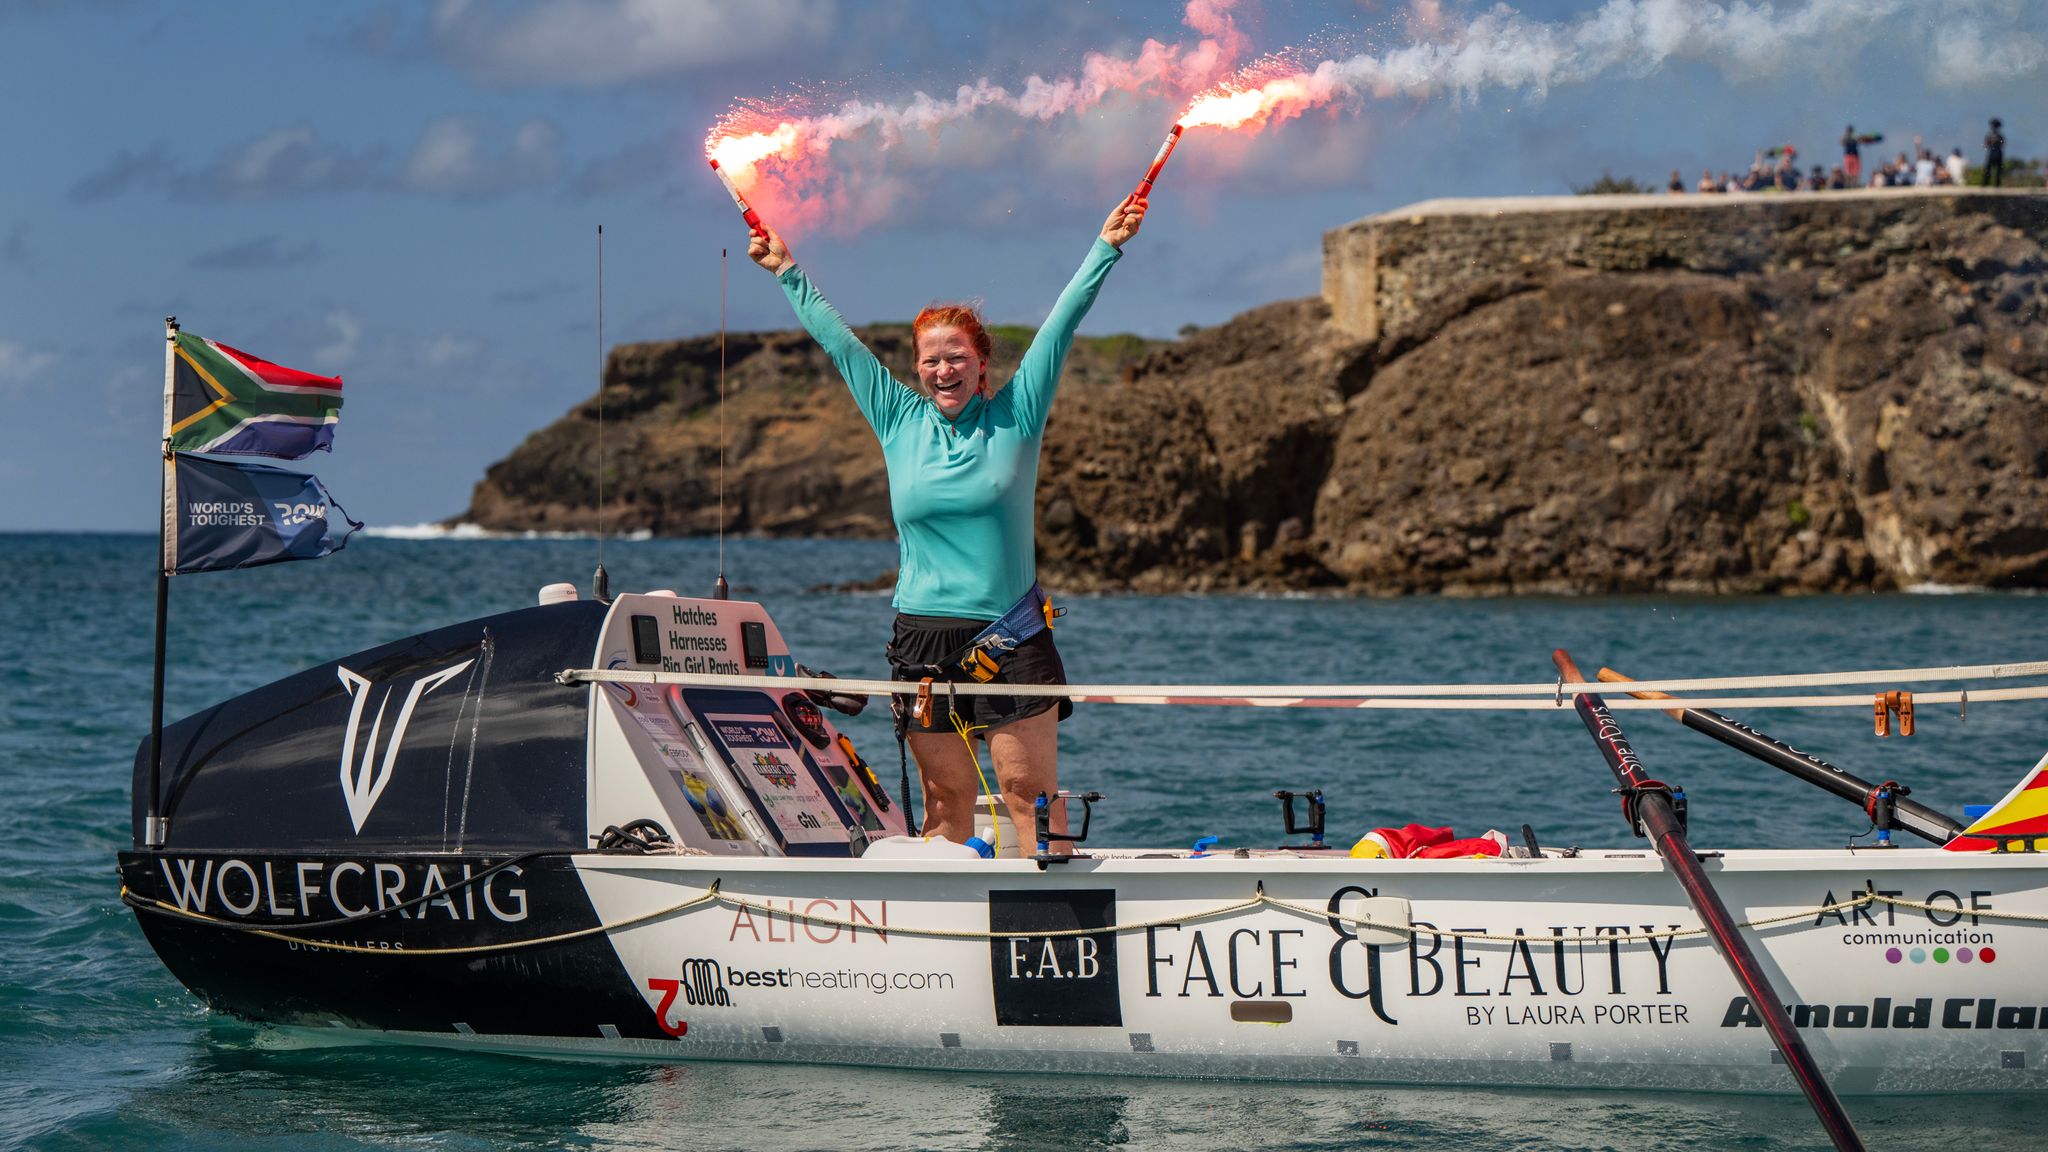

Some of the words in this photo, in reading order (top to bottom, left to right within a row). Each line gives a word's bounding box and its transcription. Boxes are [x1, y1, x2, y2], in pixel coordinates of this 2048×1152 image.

[188, 502, 254, 514] WORLD'S
[188, 514, 265, 526] TOUGHEST
[672, 605, 718, 626] Hatches
[668, 630, 728, 652] Harnesses
[662, 655, 681, 673] Big
[684, 656, 706, 674] Girl
[709, 657, 740, 675] Pants
[797, 811, 822, 829] Gill
[159, 858, 529, 923] WOLFCRAIG
[1814, 889, 1903, 927] ART
[1925, 889, 1993, 928] OF
[729, 899, 888, 945] ALIGN
[1843, 929, 1994, 945] communication
[1009, 936, 1100, 980] F.A.B
[1144, 923, 1307, 998] FACE
[1406, 922, 1682, 998] BEAUTY
[727, 966, 954, 995] bestheating.com
[1466, 1006, 1494, 1026] BY
[1506, 1005, 1586, 1025] LAURA
[1595, 1004, 1689, 1025] PORTER
[1720, 996, 1933, 1029] Anold
